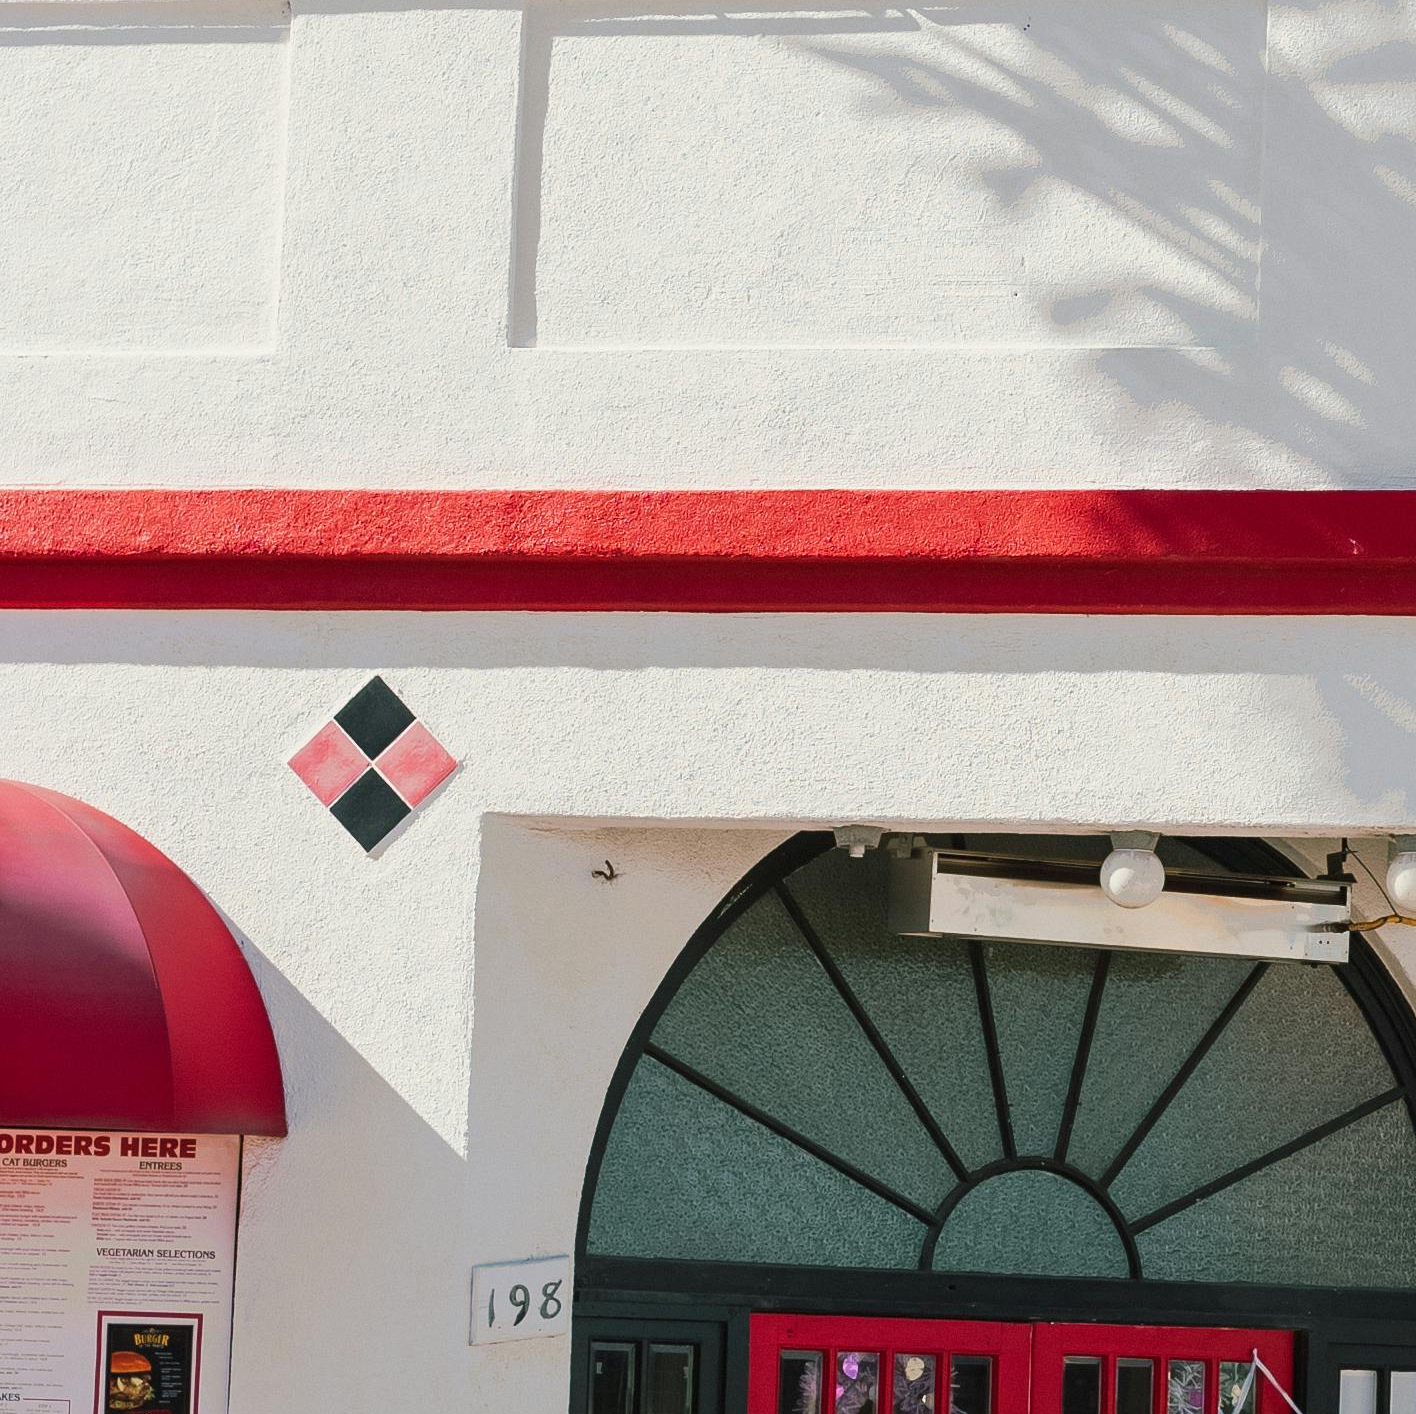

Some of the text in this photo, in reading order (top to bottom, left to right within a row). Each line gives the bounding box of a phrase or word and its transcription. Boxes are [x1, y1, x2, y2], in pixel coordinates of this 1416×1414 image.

[0, 1133, 197, 1159] ORDERS HERE
[2, 1157, 68, 1168] CAT BURGERS
[139, 1160, 183, 1171] ENTREES
[96, 1247, 217, 1260] VEGETARIAN SELECTIONS
[487, 1278, 563, 1328] 198
[133, 1333, 171, 1347] BURGER
[0, 1392, 21, 1402] KES
